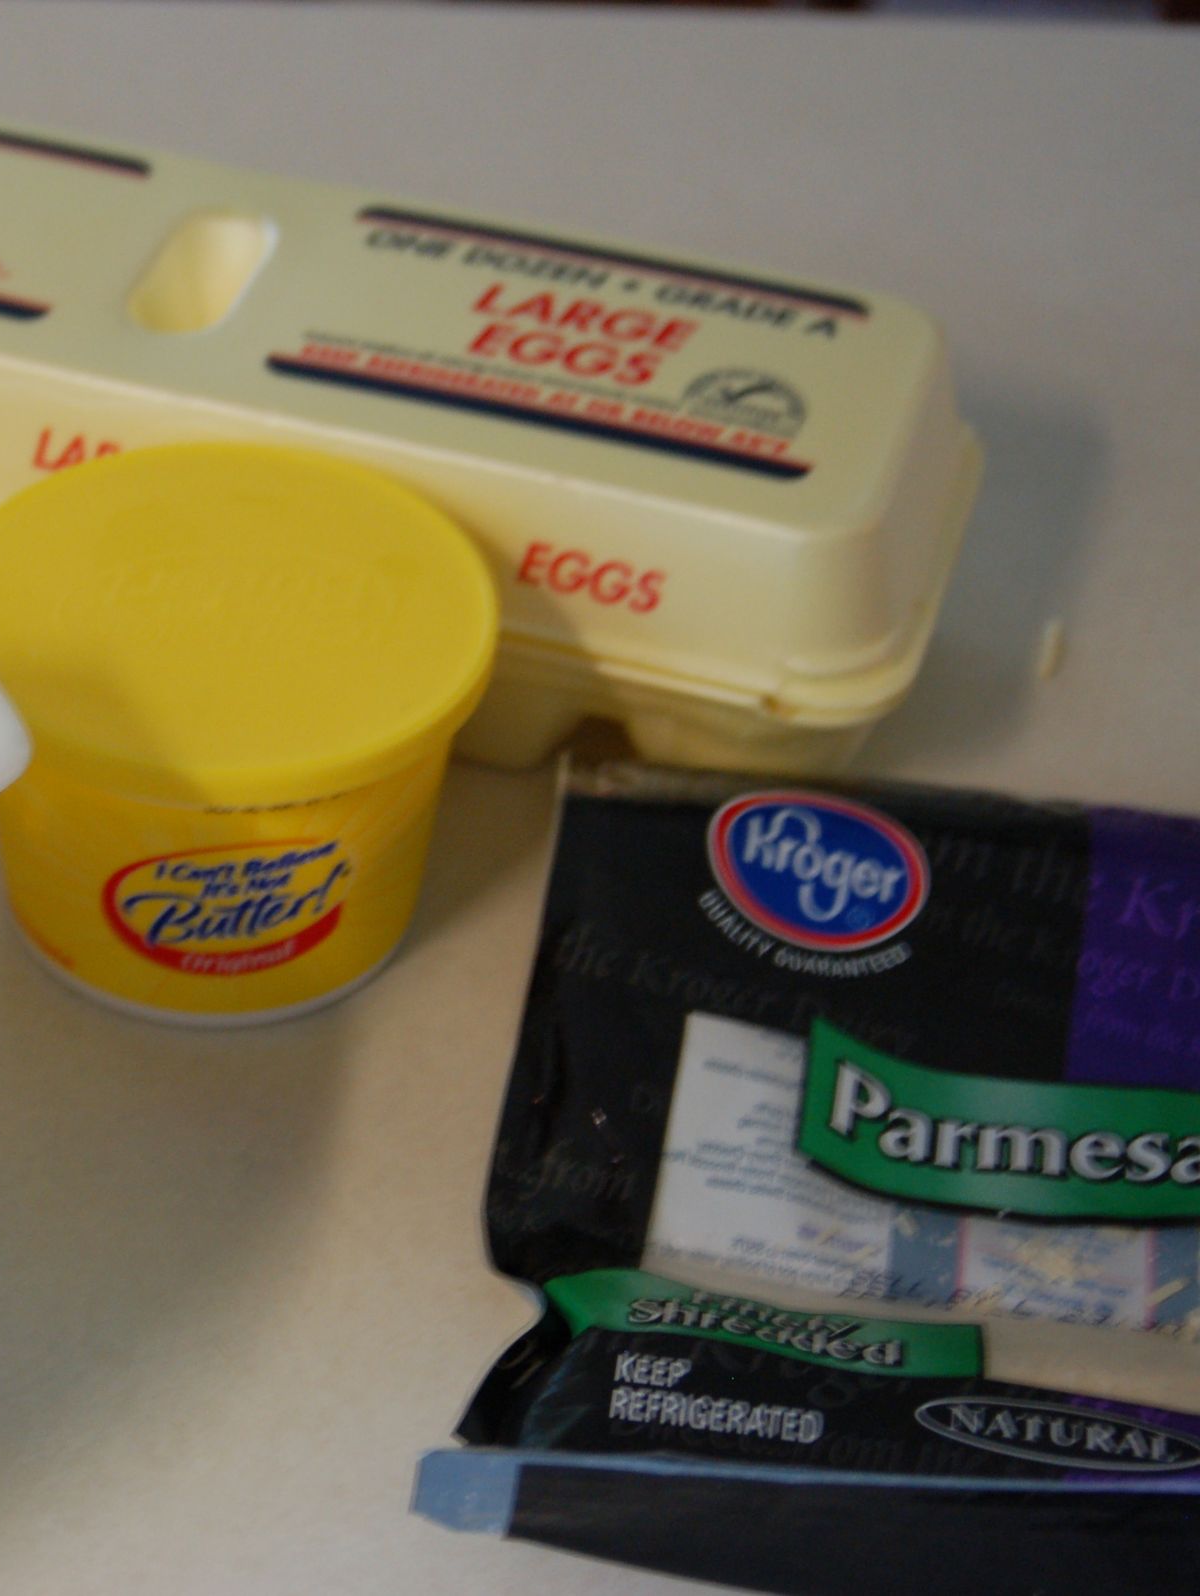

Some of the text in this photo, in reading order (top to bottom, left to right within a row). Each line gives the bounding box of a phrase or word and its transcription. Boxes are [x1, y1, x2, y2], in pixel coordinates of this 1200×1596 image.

[365, 228, 840, 340] ONE DOZEN GRADE A
[473, 282, 700, 354] LARGE
[467, 322, 665, 388] EGGS
[517, 540, 668, 616] EGGS
[742, 807, 904, 922] Kroger
[699, 889, 913, 978] QUALITY GUARANTEED
[628, 1296, 903, 1367] Shredded
[613, 1351, 693, 1389] KEEP
[608, 1385, 825, 1444] REFRIGERATED
[950, 1402, 1186, 1463] NATURAL
